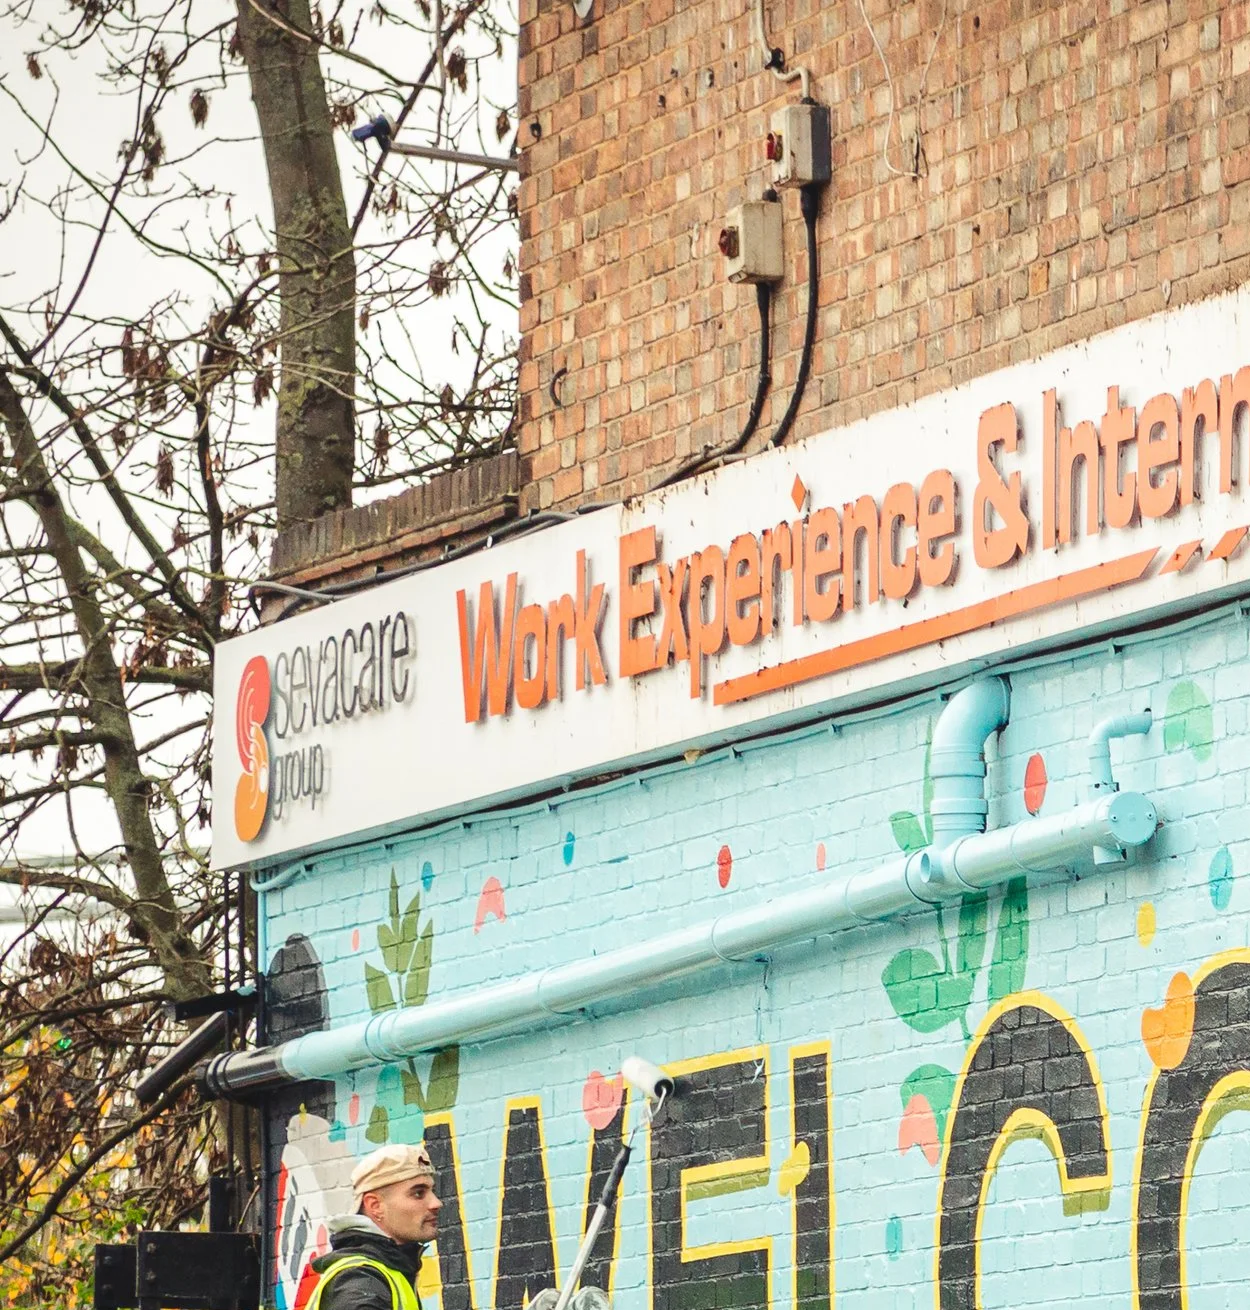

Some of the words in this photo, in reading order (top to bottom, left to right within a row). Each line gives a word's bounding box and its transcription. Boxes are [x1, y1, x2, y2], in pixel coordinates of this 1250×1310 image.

[457, 550, 606, 724] Work
[618, 470, 956, 698] Experience
[973, 402, 1029, 569] &
[274, 611, 410, 738] sevacare
[273, 744, 324, 820] group
